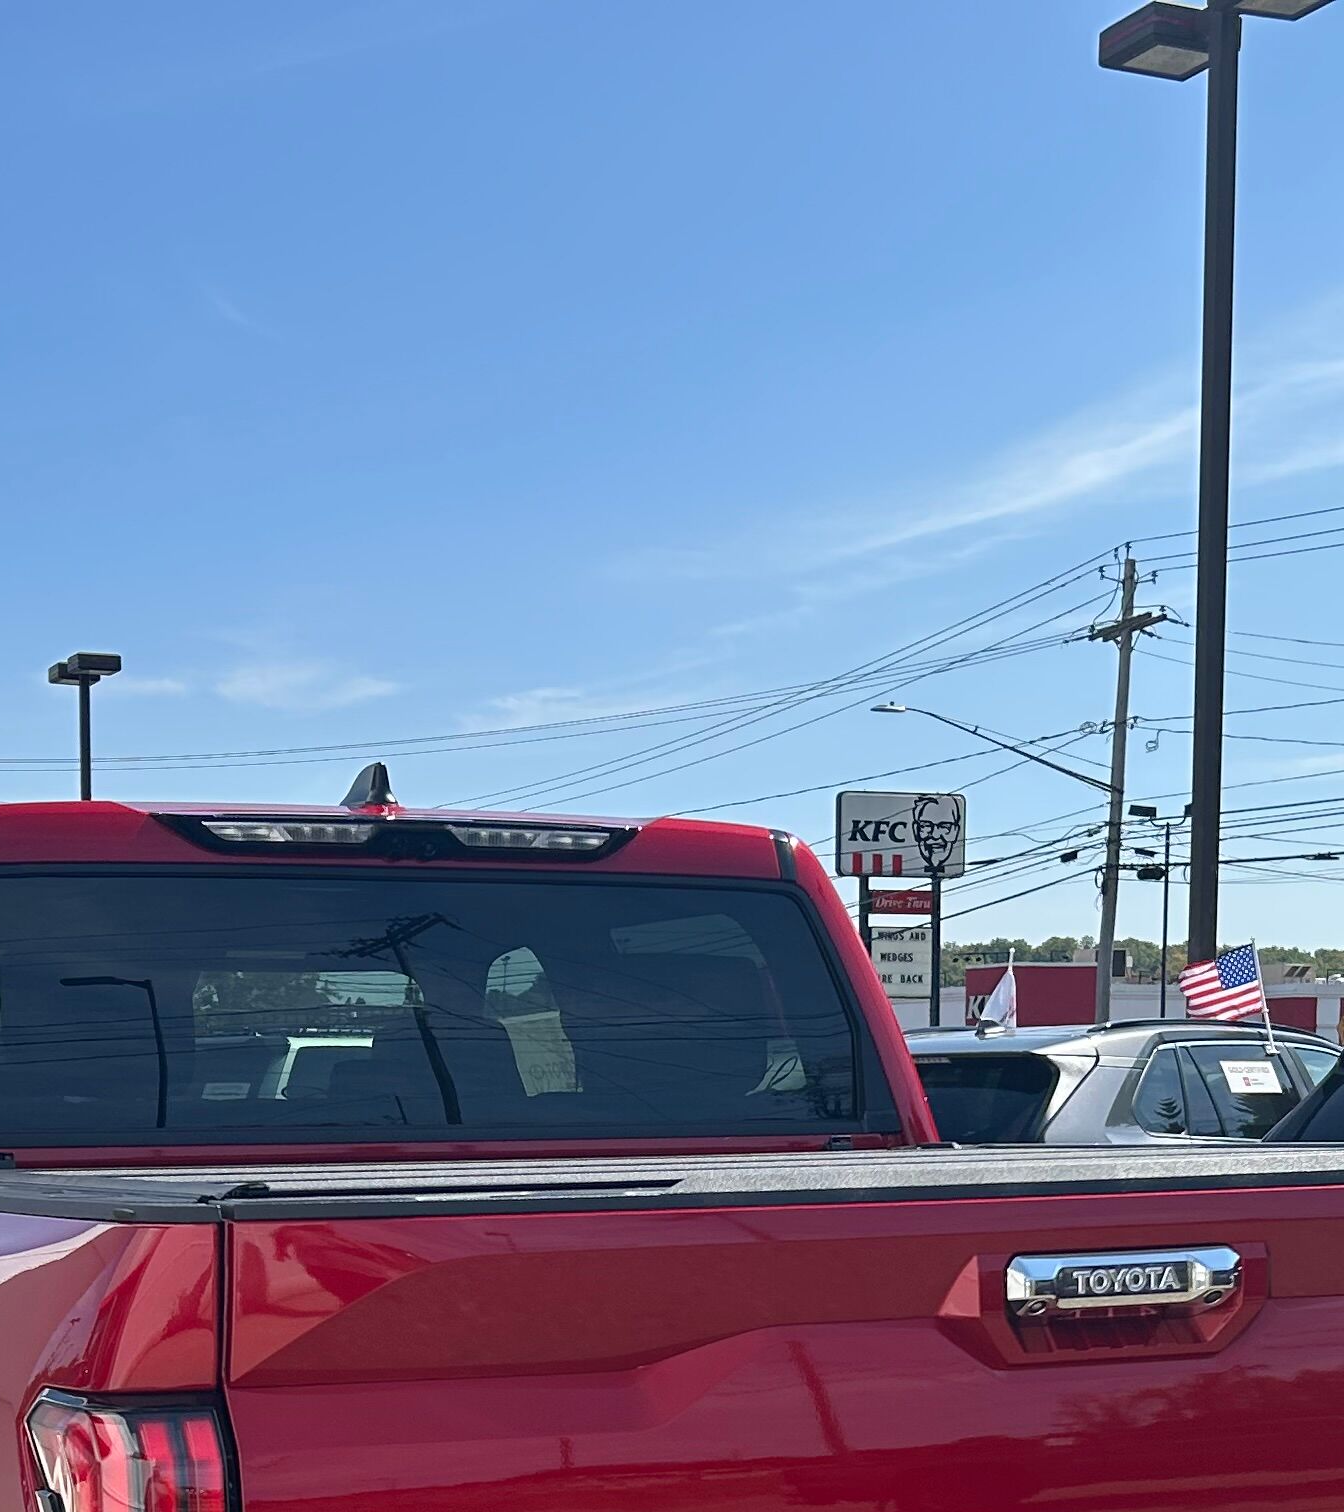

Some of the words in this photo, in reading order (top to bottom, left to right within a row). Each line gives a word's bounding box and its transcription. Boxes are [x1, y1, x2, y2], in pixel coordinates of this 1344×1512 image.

[847, 819, 908, 843] KFC
[875, 897, 904, 909] Drive
[906, 896, 931, 909] Thru
[909, 931, 926, 941] AND
[879, 952, 914, 963] WEDGES
[878, 974, 893, 984] RE
[900, 974, 924, 984] BACK
[1072, 1266, 1181, 1295] TOYOTA
